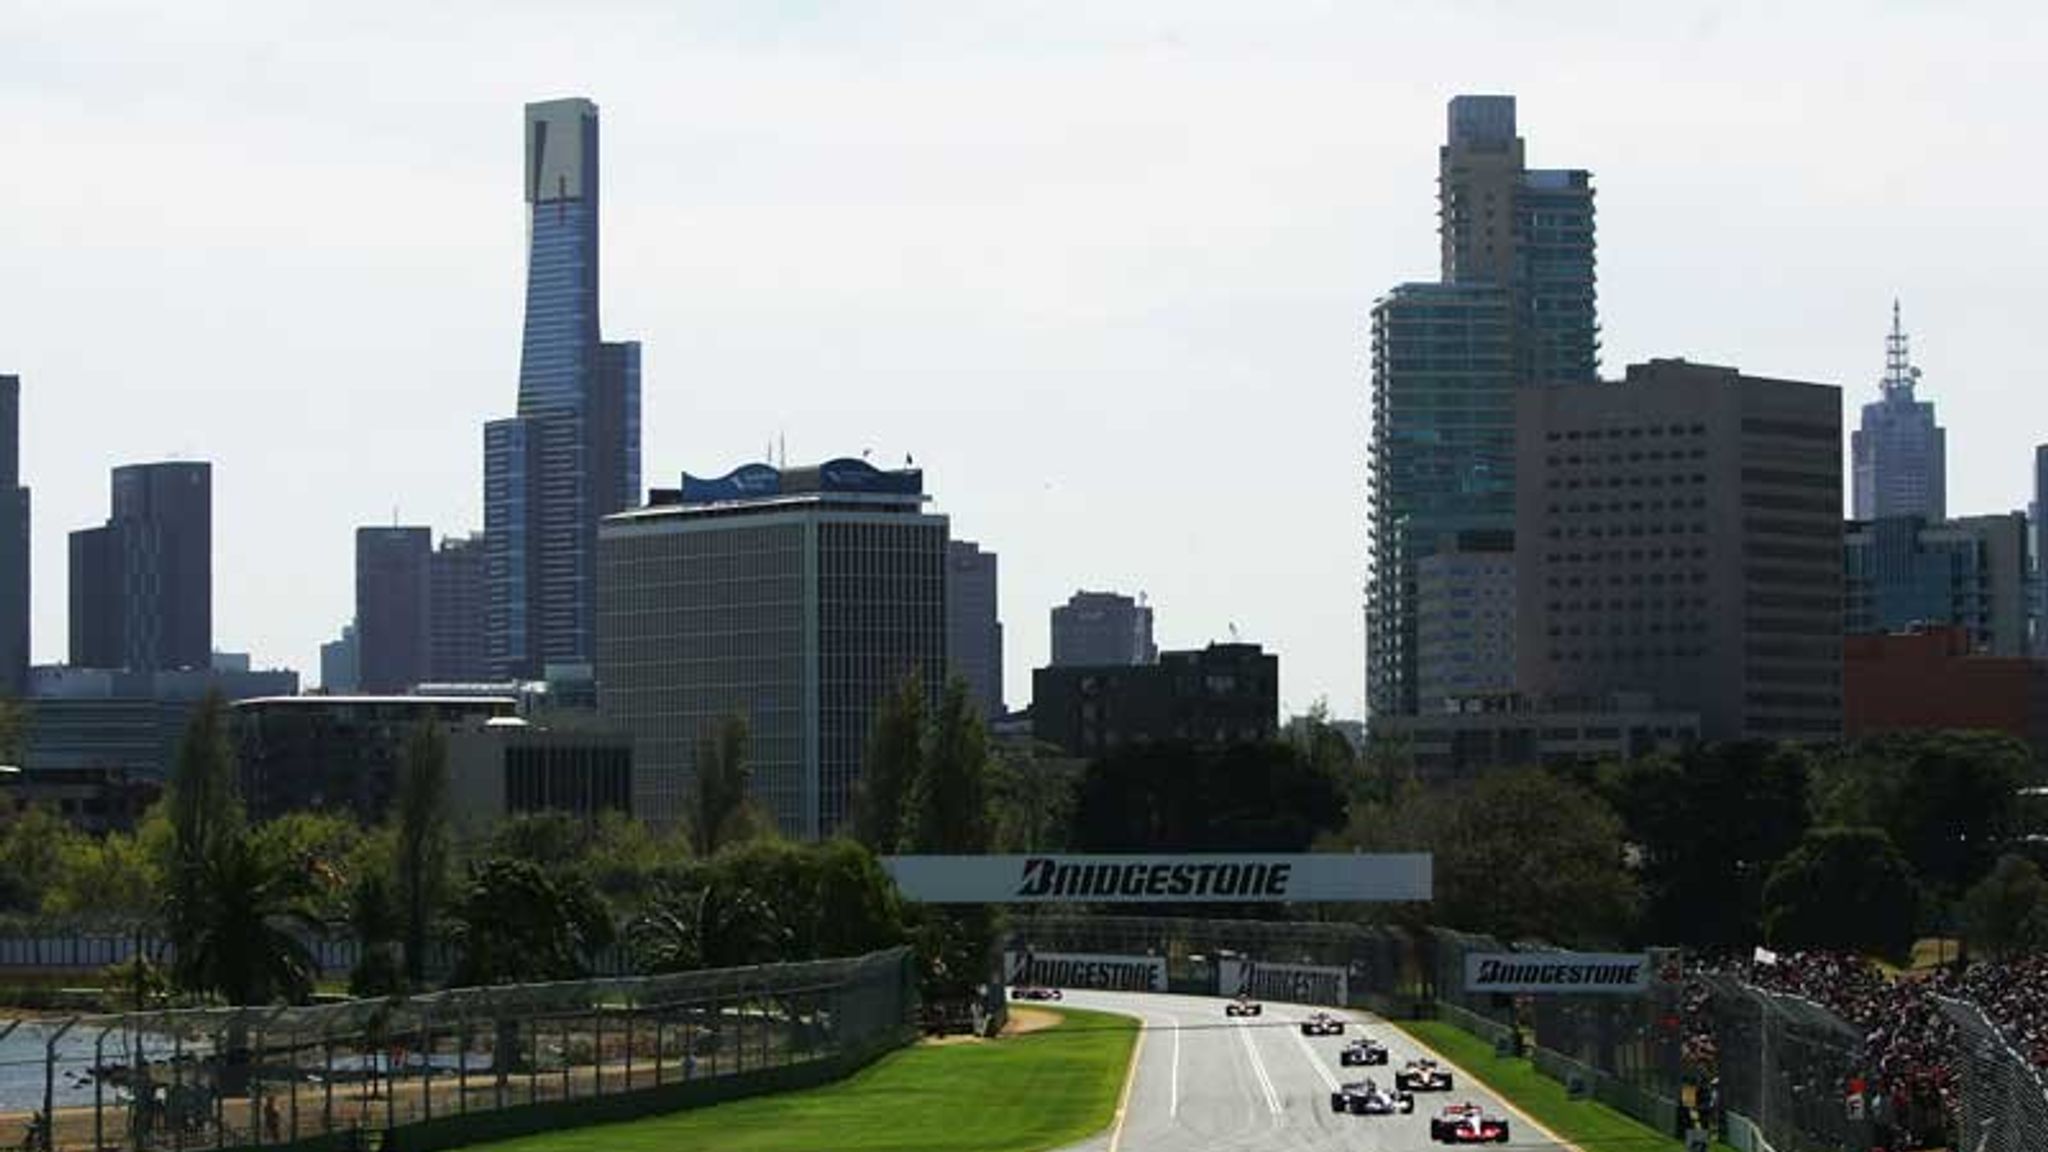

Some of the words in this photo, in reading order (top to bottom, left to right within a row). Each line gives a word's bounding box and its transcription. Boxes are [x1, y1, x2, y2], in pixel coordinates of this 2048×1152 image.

[1018, 858, 1291, 896] BRIDGESTONE
[1012, 953, 1158, 991] BRIDGESTONE
[1477, 960, 1641, 984] BRIDGESTONE
